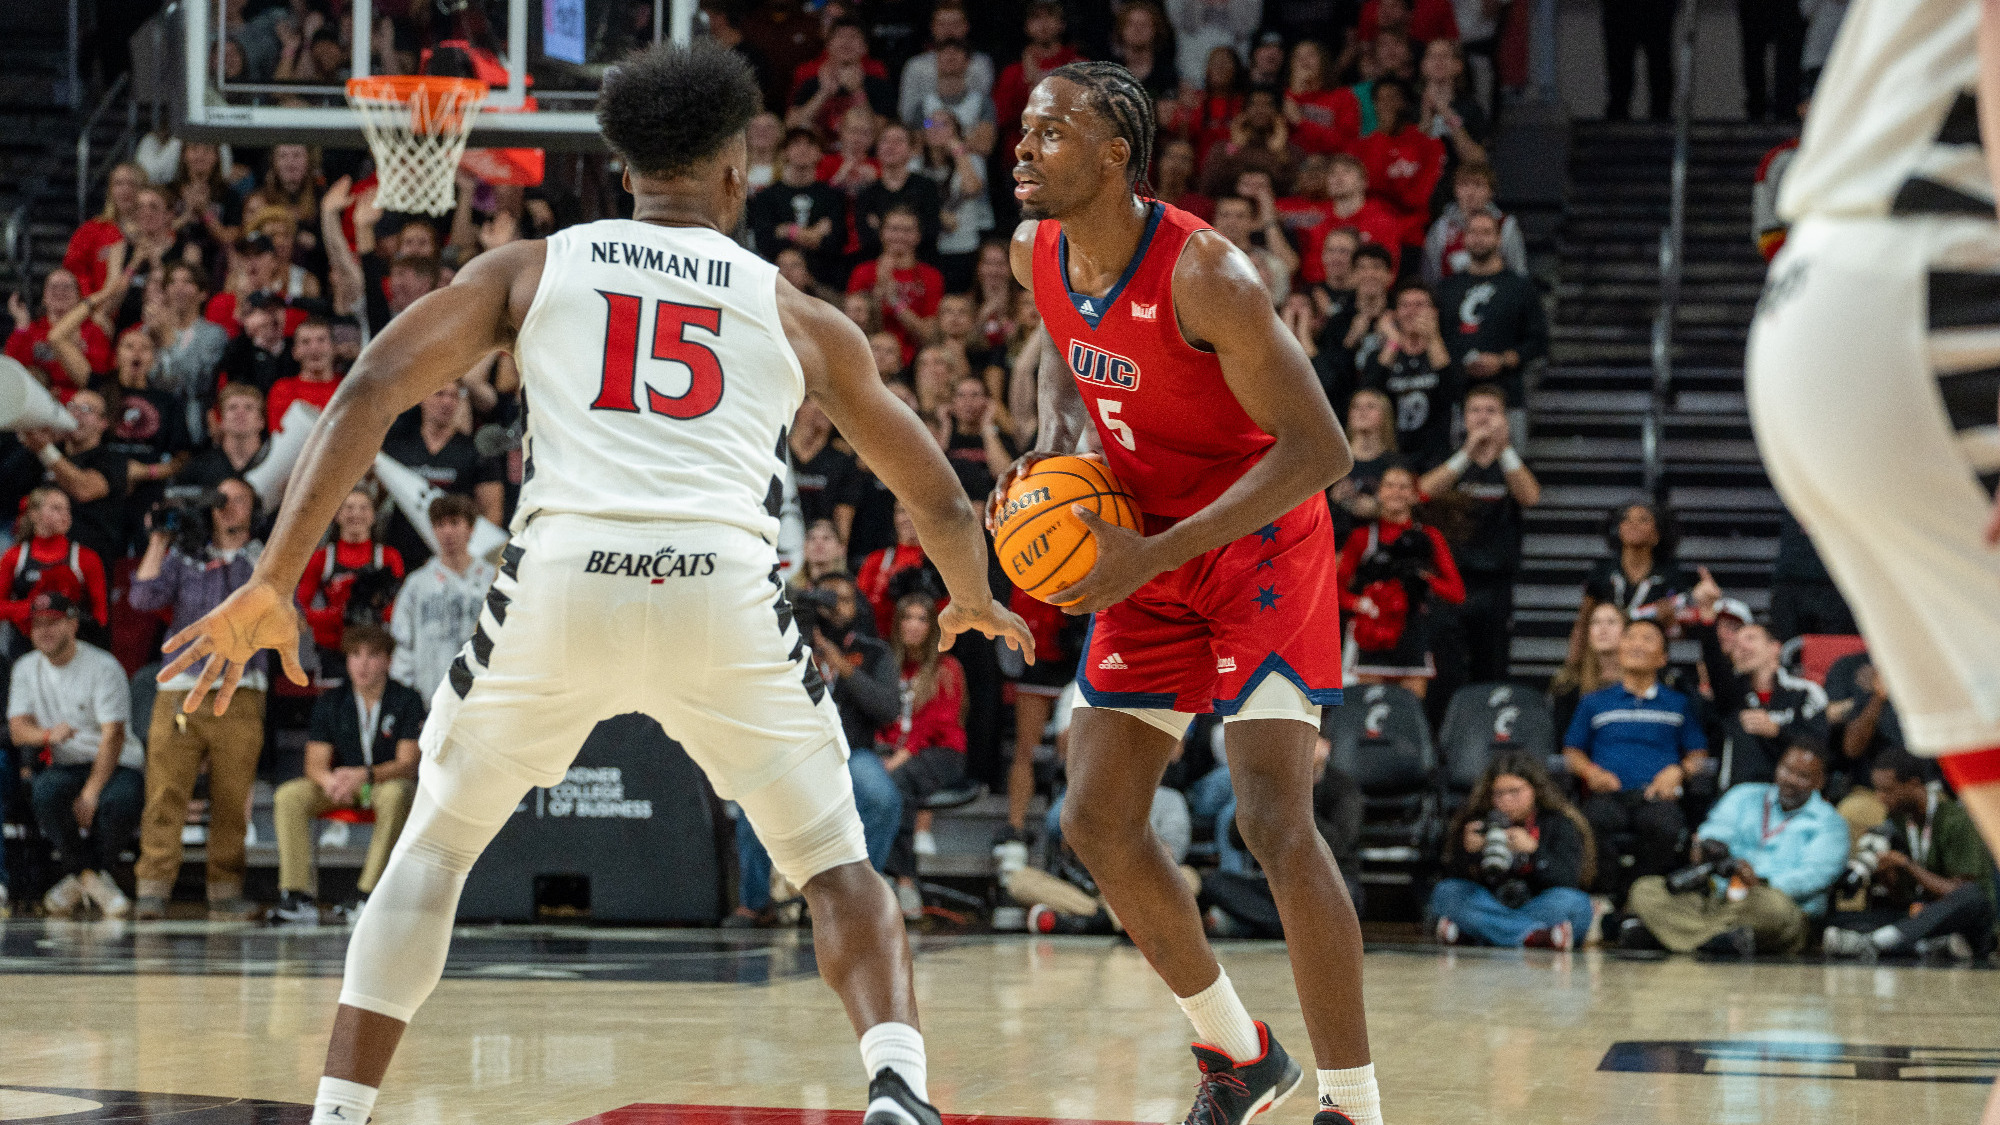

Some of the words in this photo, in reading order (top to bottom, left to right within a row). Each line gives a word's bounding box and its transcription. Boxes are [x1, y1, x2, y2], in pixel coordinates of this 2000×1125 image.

[591, 242, 699, 283] NEWMAN
[707, 259, 732, 288] III
[589, 288, 725, 420] 15
[1071, 343, 1137, 388] UIC
[1096, 397, 1136, 451] 5
[583, 546, 718, 584] BEARCATS
[1098, 662, 1129, 670] adidas
[550, 783, 625, 800] COLLEGE
[563, 766, 622, 783] NDNER
[548, 800, 573, 817] OF
[575, 800, 653, 819] BUSINESS
